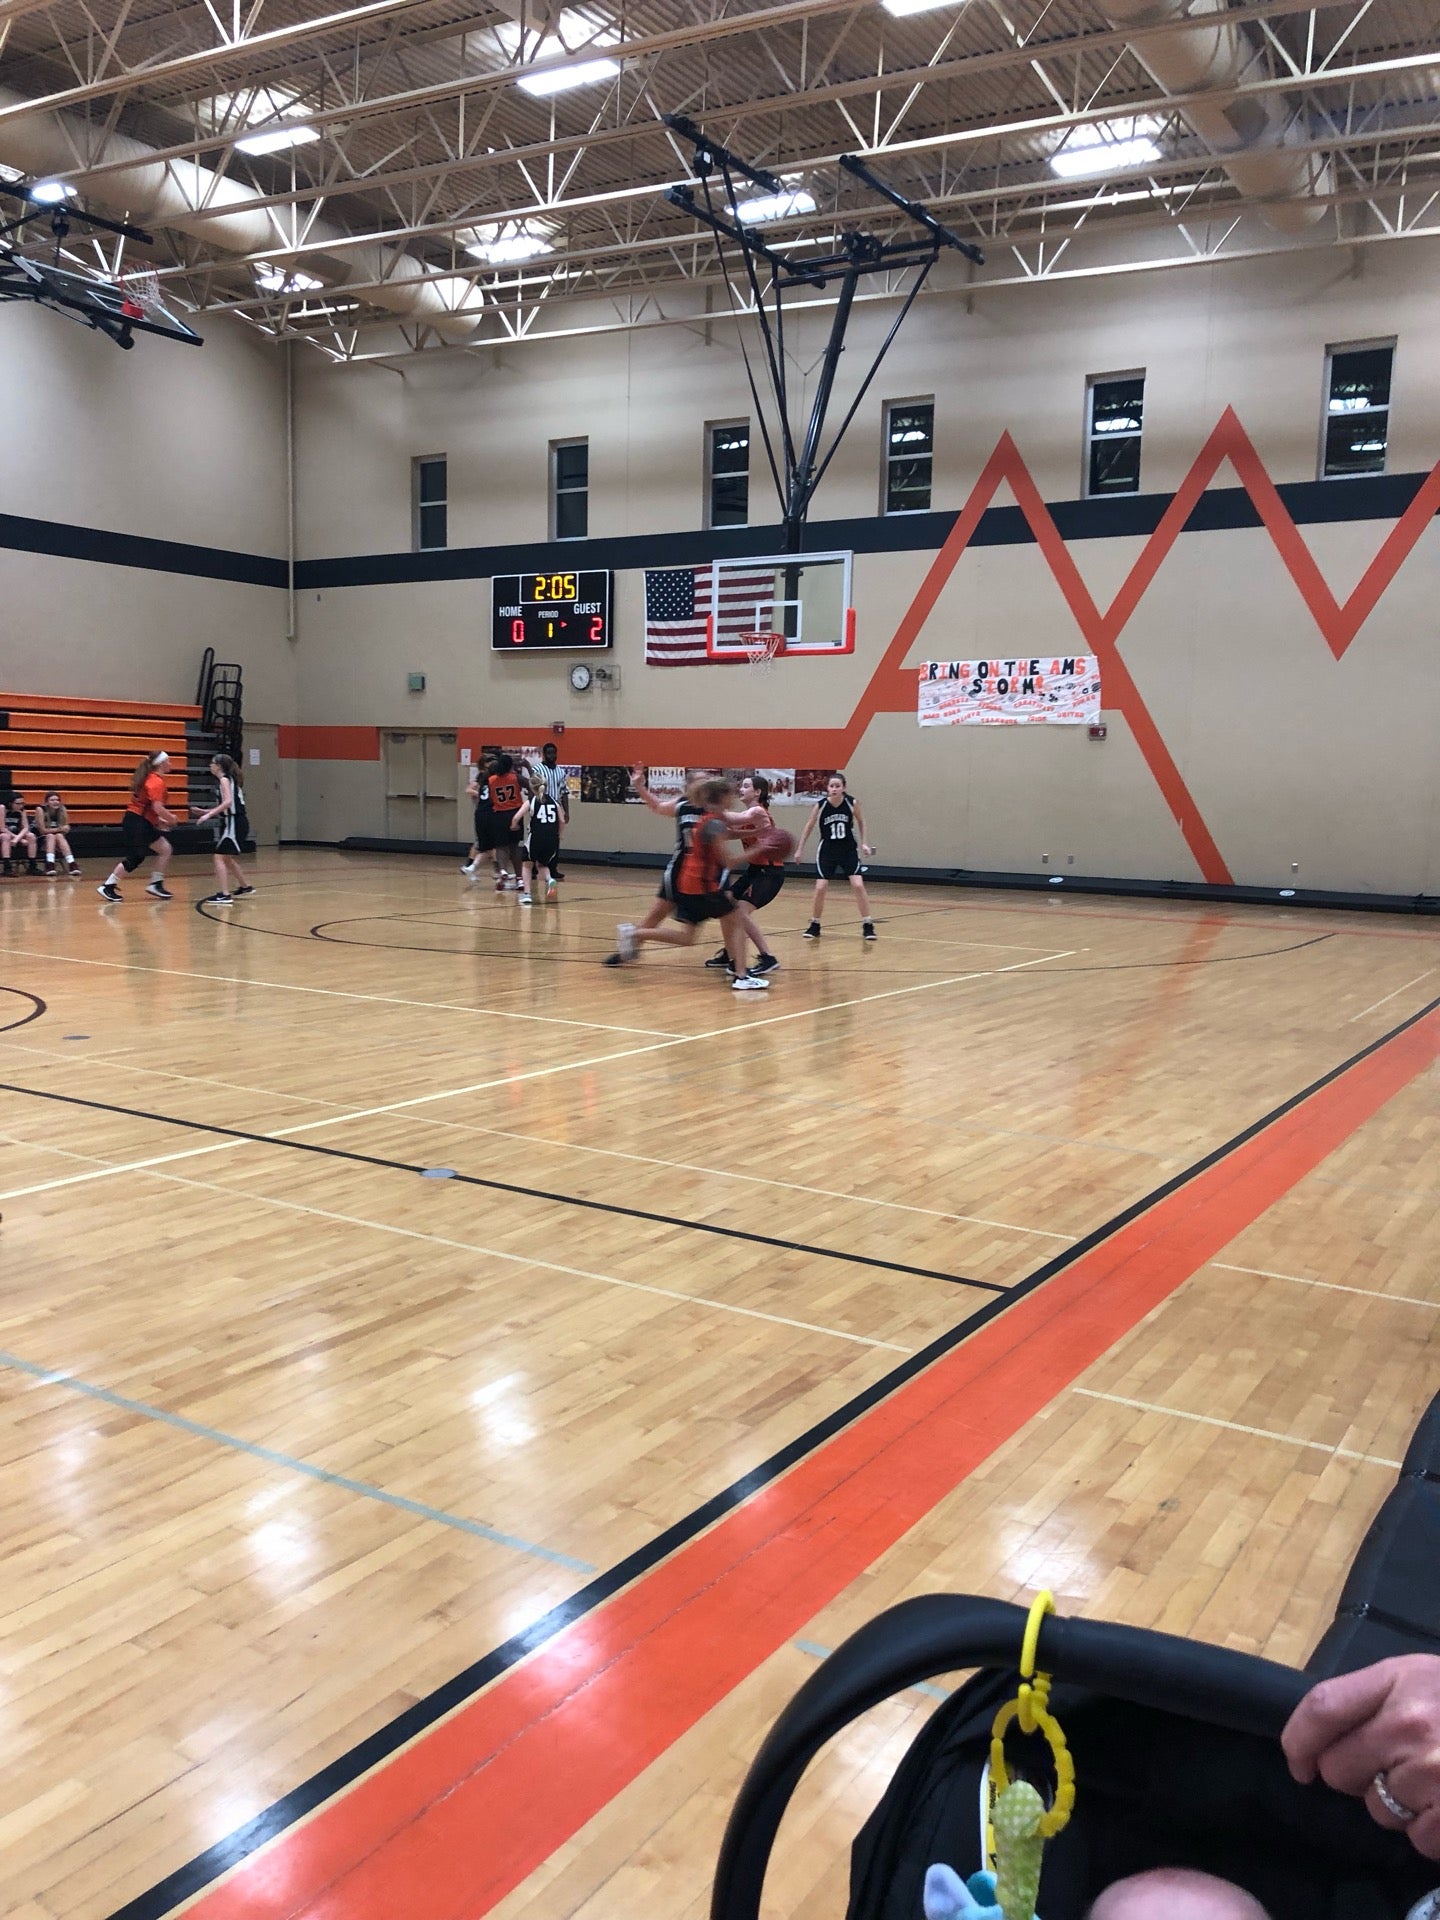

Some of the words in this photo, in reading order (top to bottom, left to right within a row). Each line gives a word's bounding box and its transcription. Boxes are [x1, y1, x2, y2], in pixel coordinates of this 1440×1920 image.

[535, 575, 575, 600] 2:05
[499, 606, 523, 617] HOME
[537, 610, 559, 619] PERIOD
[573, 602, 602, 615] GUEST
[512, 620, 525, 643] 0
[547, 622, 554, 638] 1
[589, 616, 603, 641] 2
[919, 663, 970, 681] BRING
[977, 661, 1000, 679] ON
[1004, 659, 1040, 677] THE
[1049, 657, 1086, 676] AMS
[495, 784, 517, 803] 52
[536, 804, 557, 824] 45
[830, 822, 847, 840] 10
